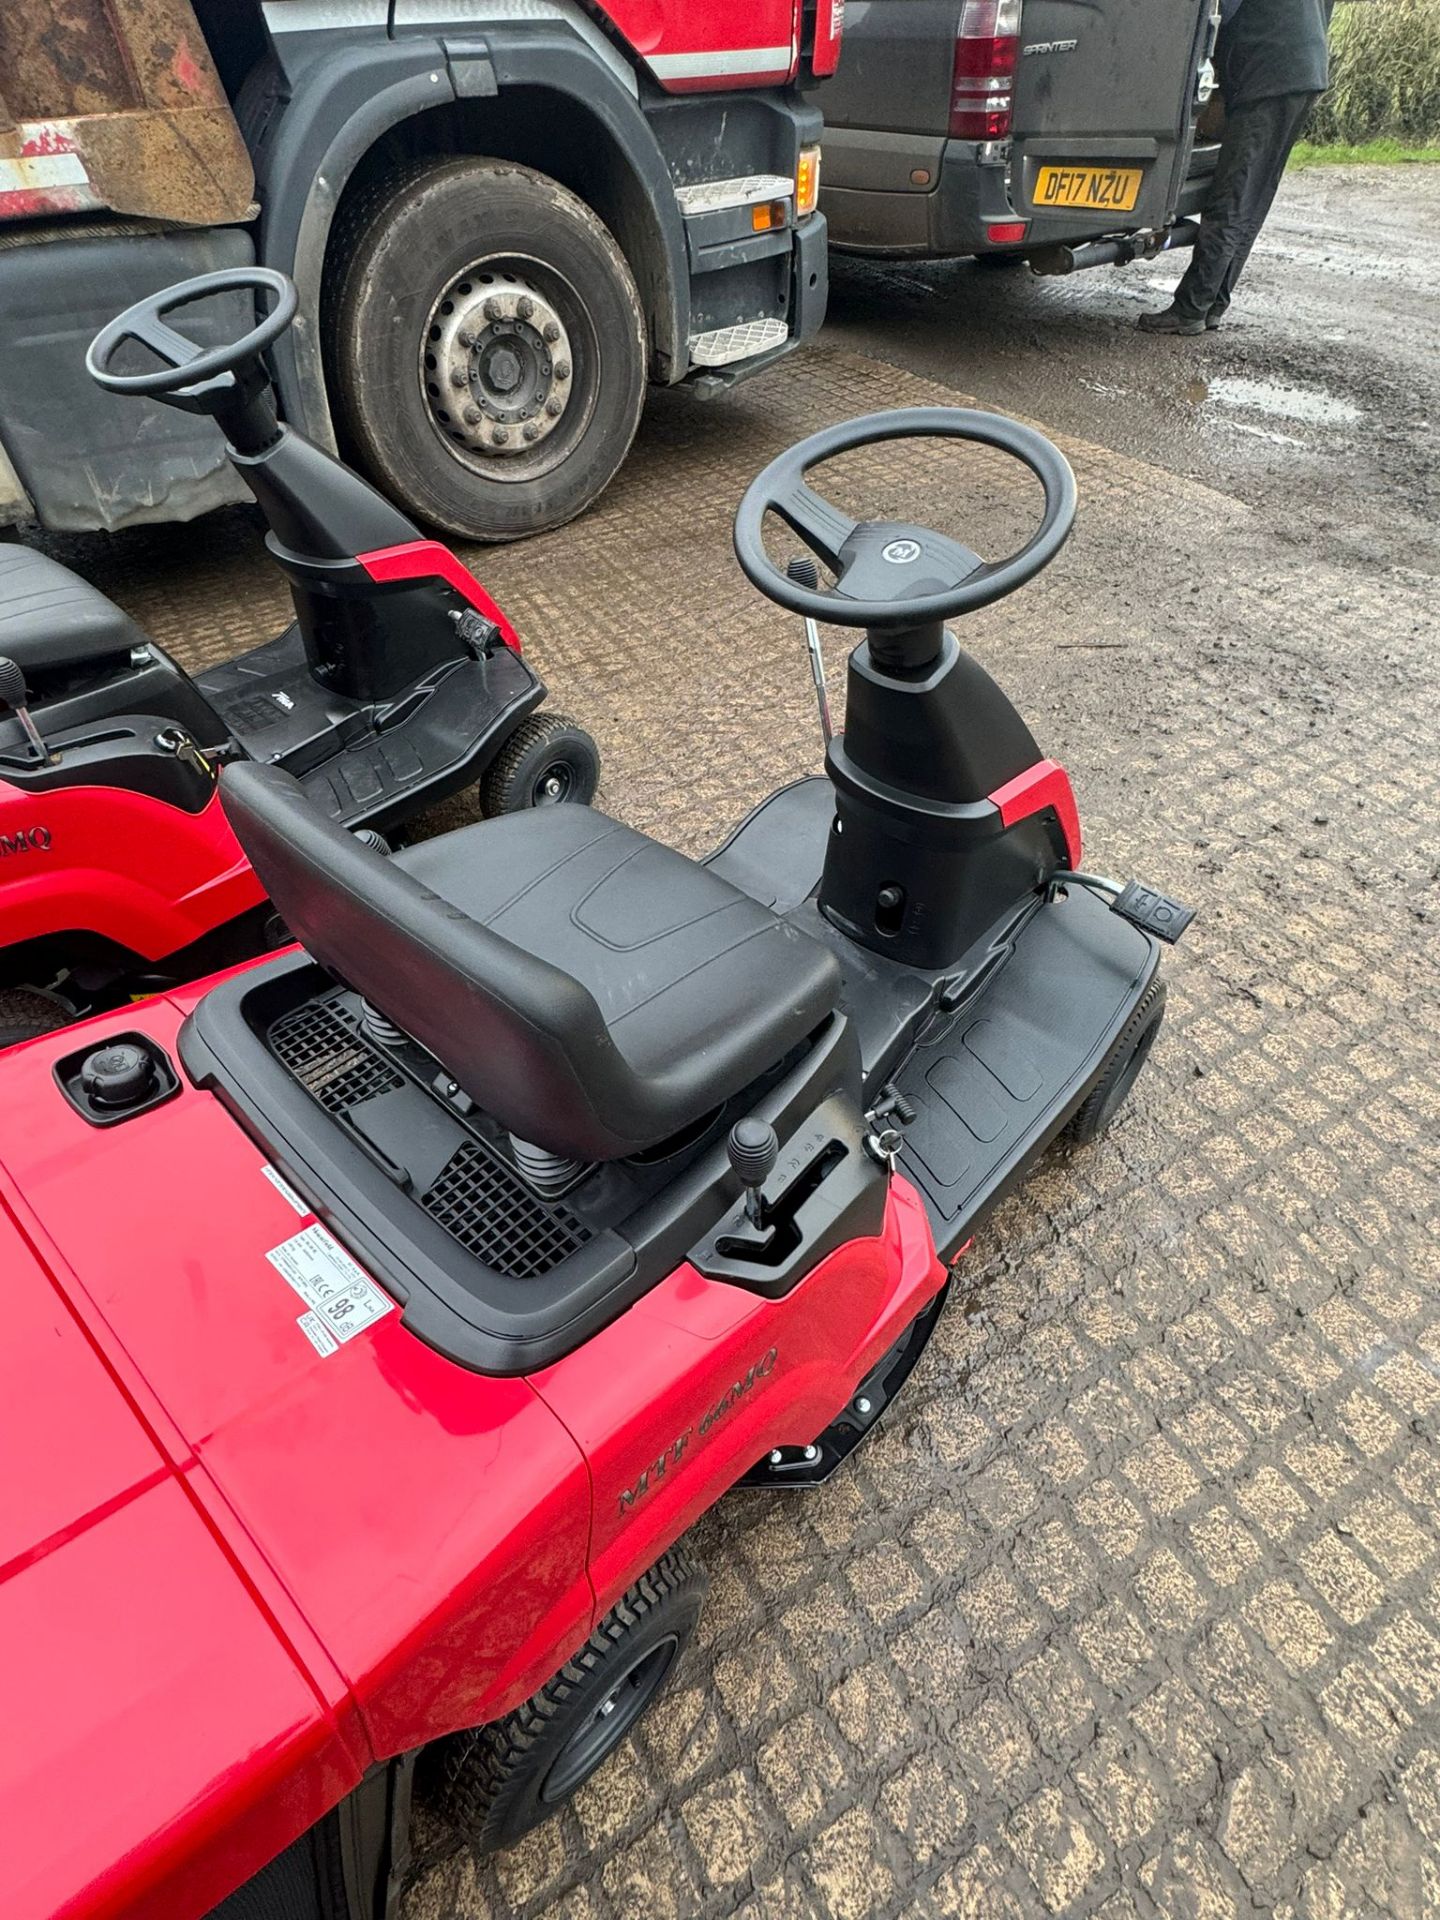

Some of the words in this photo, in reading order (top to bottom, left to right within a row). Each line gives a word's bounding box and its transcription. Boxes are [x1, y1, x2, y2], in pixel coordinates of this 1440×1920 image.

[1023, 39, 1077, 56] SPRINTER
[1044, 172, 1087, 201] DF17
[1085, 173, 1129, 204] NZU
[327, 1298, 355, 1320] 98
[618, 1427, 694, 1520] MTF
